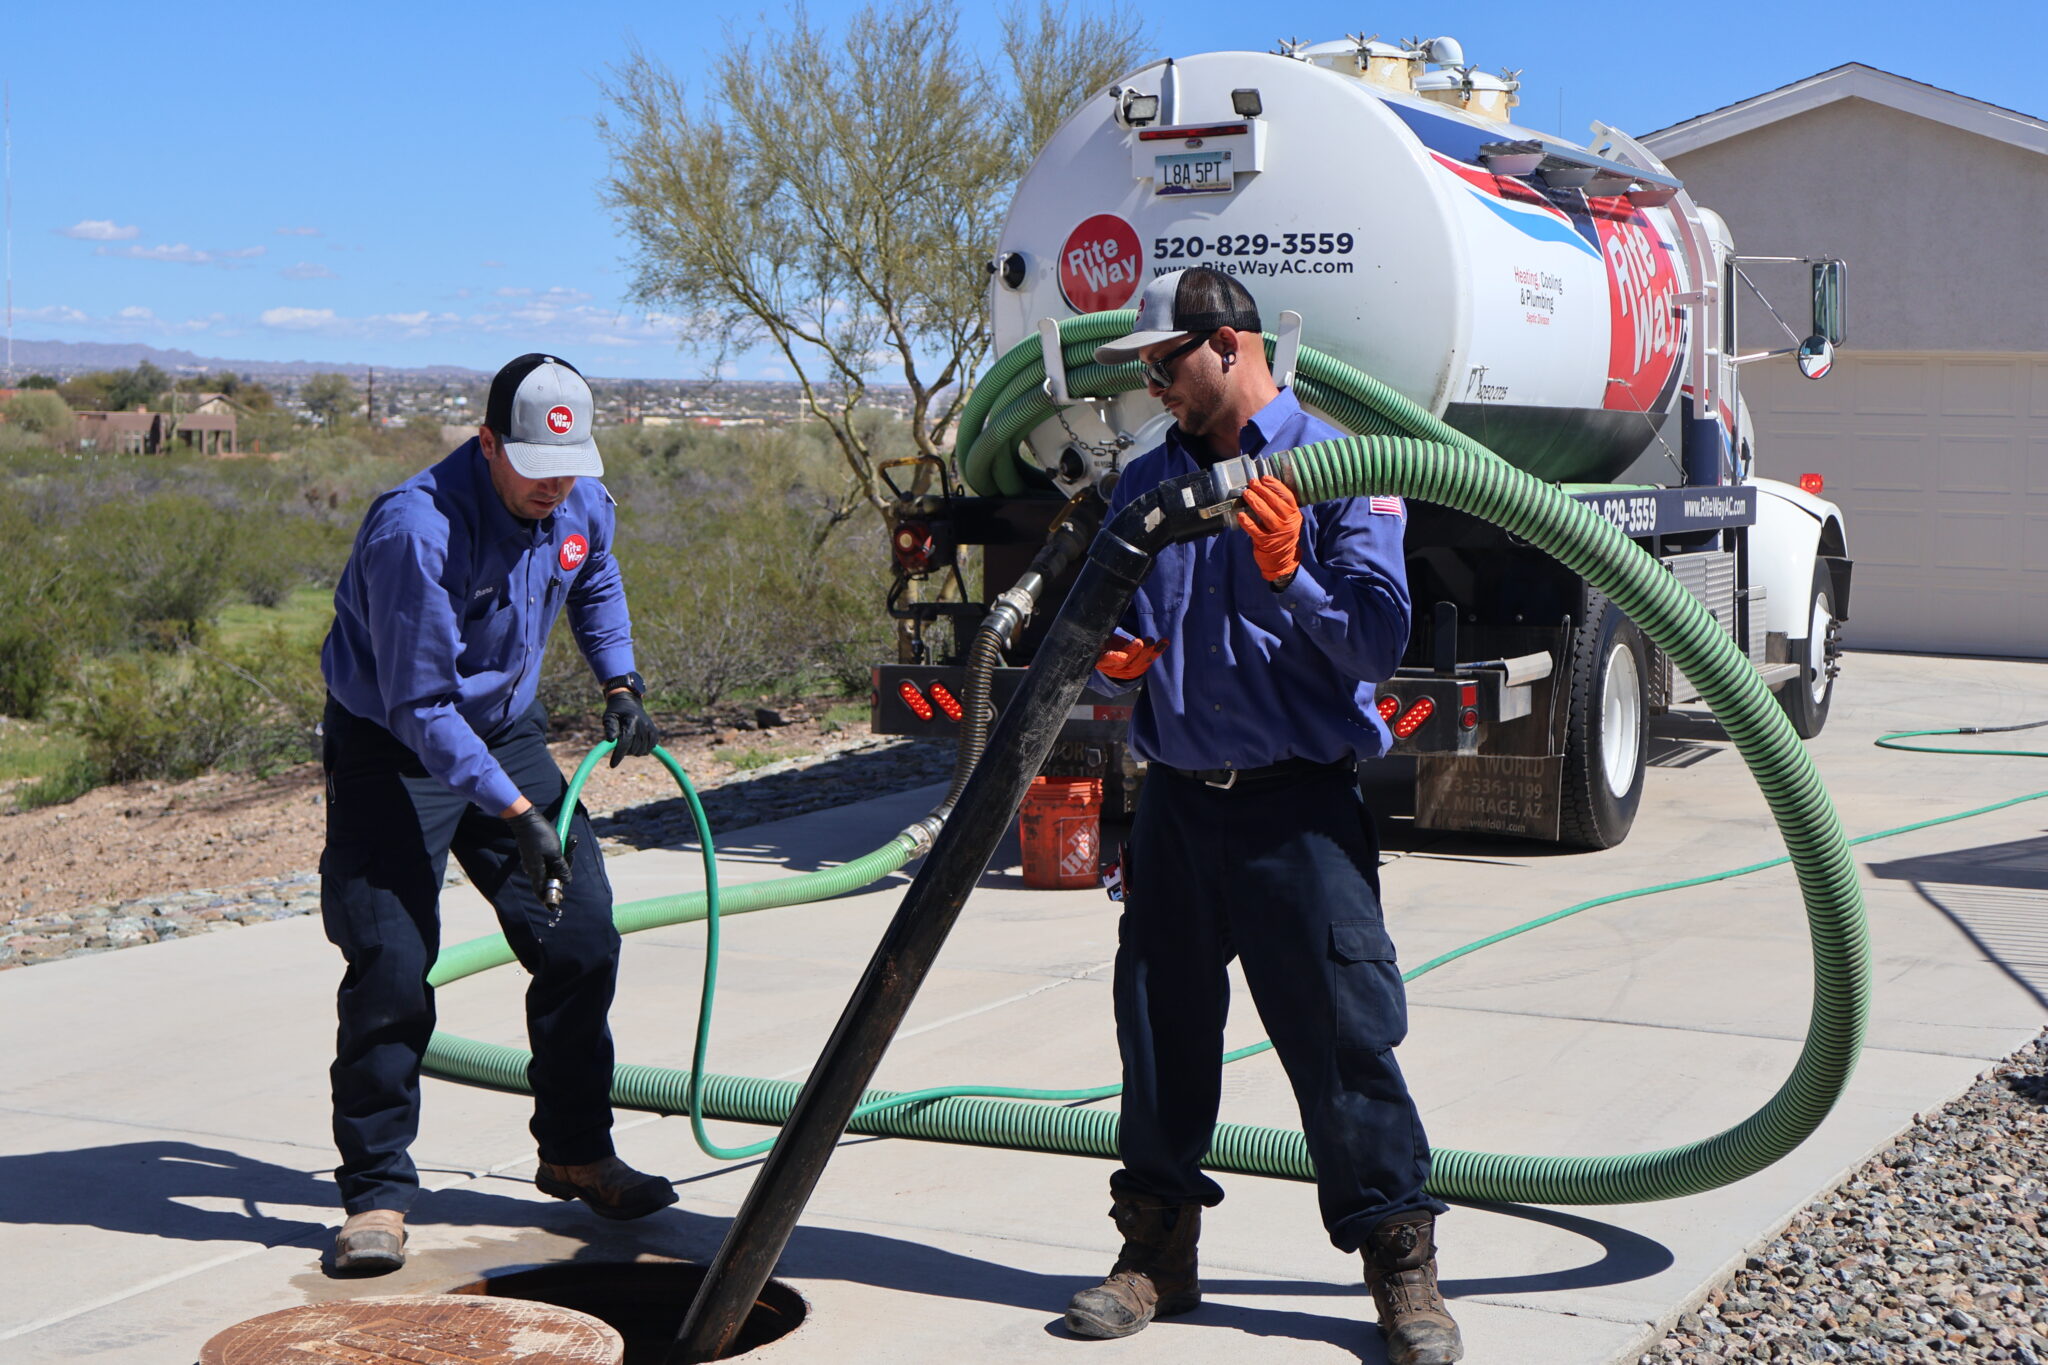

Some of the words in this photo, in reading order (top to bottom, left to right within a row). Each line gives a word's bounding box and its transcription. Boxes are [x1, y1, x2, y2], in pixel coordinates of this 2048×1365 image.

[1164, 164, 1191, 185] L8A
[1195, 161, 1222, 183] 5PT
[1153, 232, 1354, 259] 520-829-3559
[1067, 239, 1119, 277] Rite
[1153, 259, 1354, 278] wRiteWayAC.com
[1606, 220, 1656, 317] Rite
[1083, 254, 1136, 293] Way
[1541, 271, 1563, 295] Cooling
[1520, 287, 1526, 305] &
[1526, 289, 1554, 315] Plumbing
[1627, 277, 1677, 376] Way
[550, 412, 568, 421] Rite
[554, 420, 571, 429] Way
[1577, 497, 1657, 532] 0-829-3559
[1684, 496, 1746, 520] www.RiteWayAC.com
[563, 540, 582, 555] Rite
[567, 552, 585, 564] Way
[1523, 803, 1543, 819] AZ
